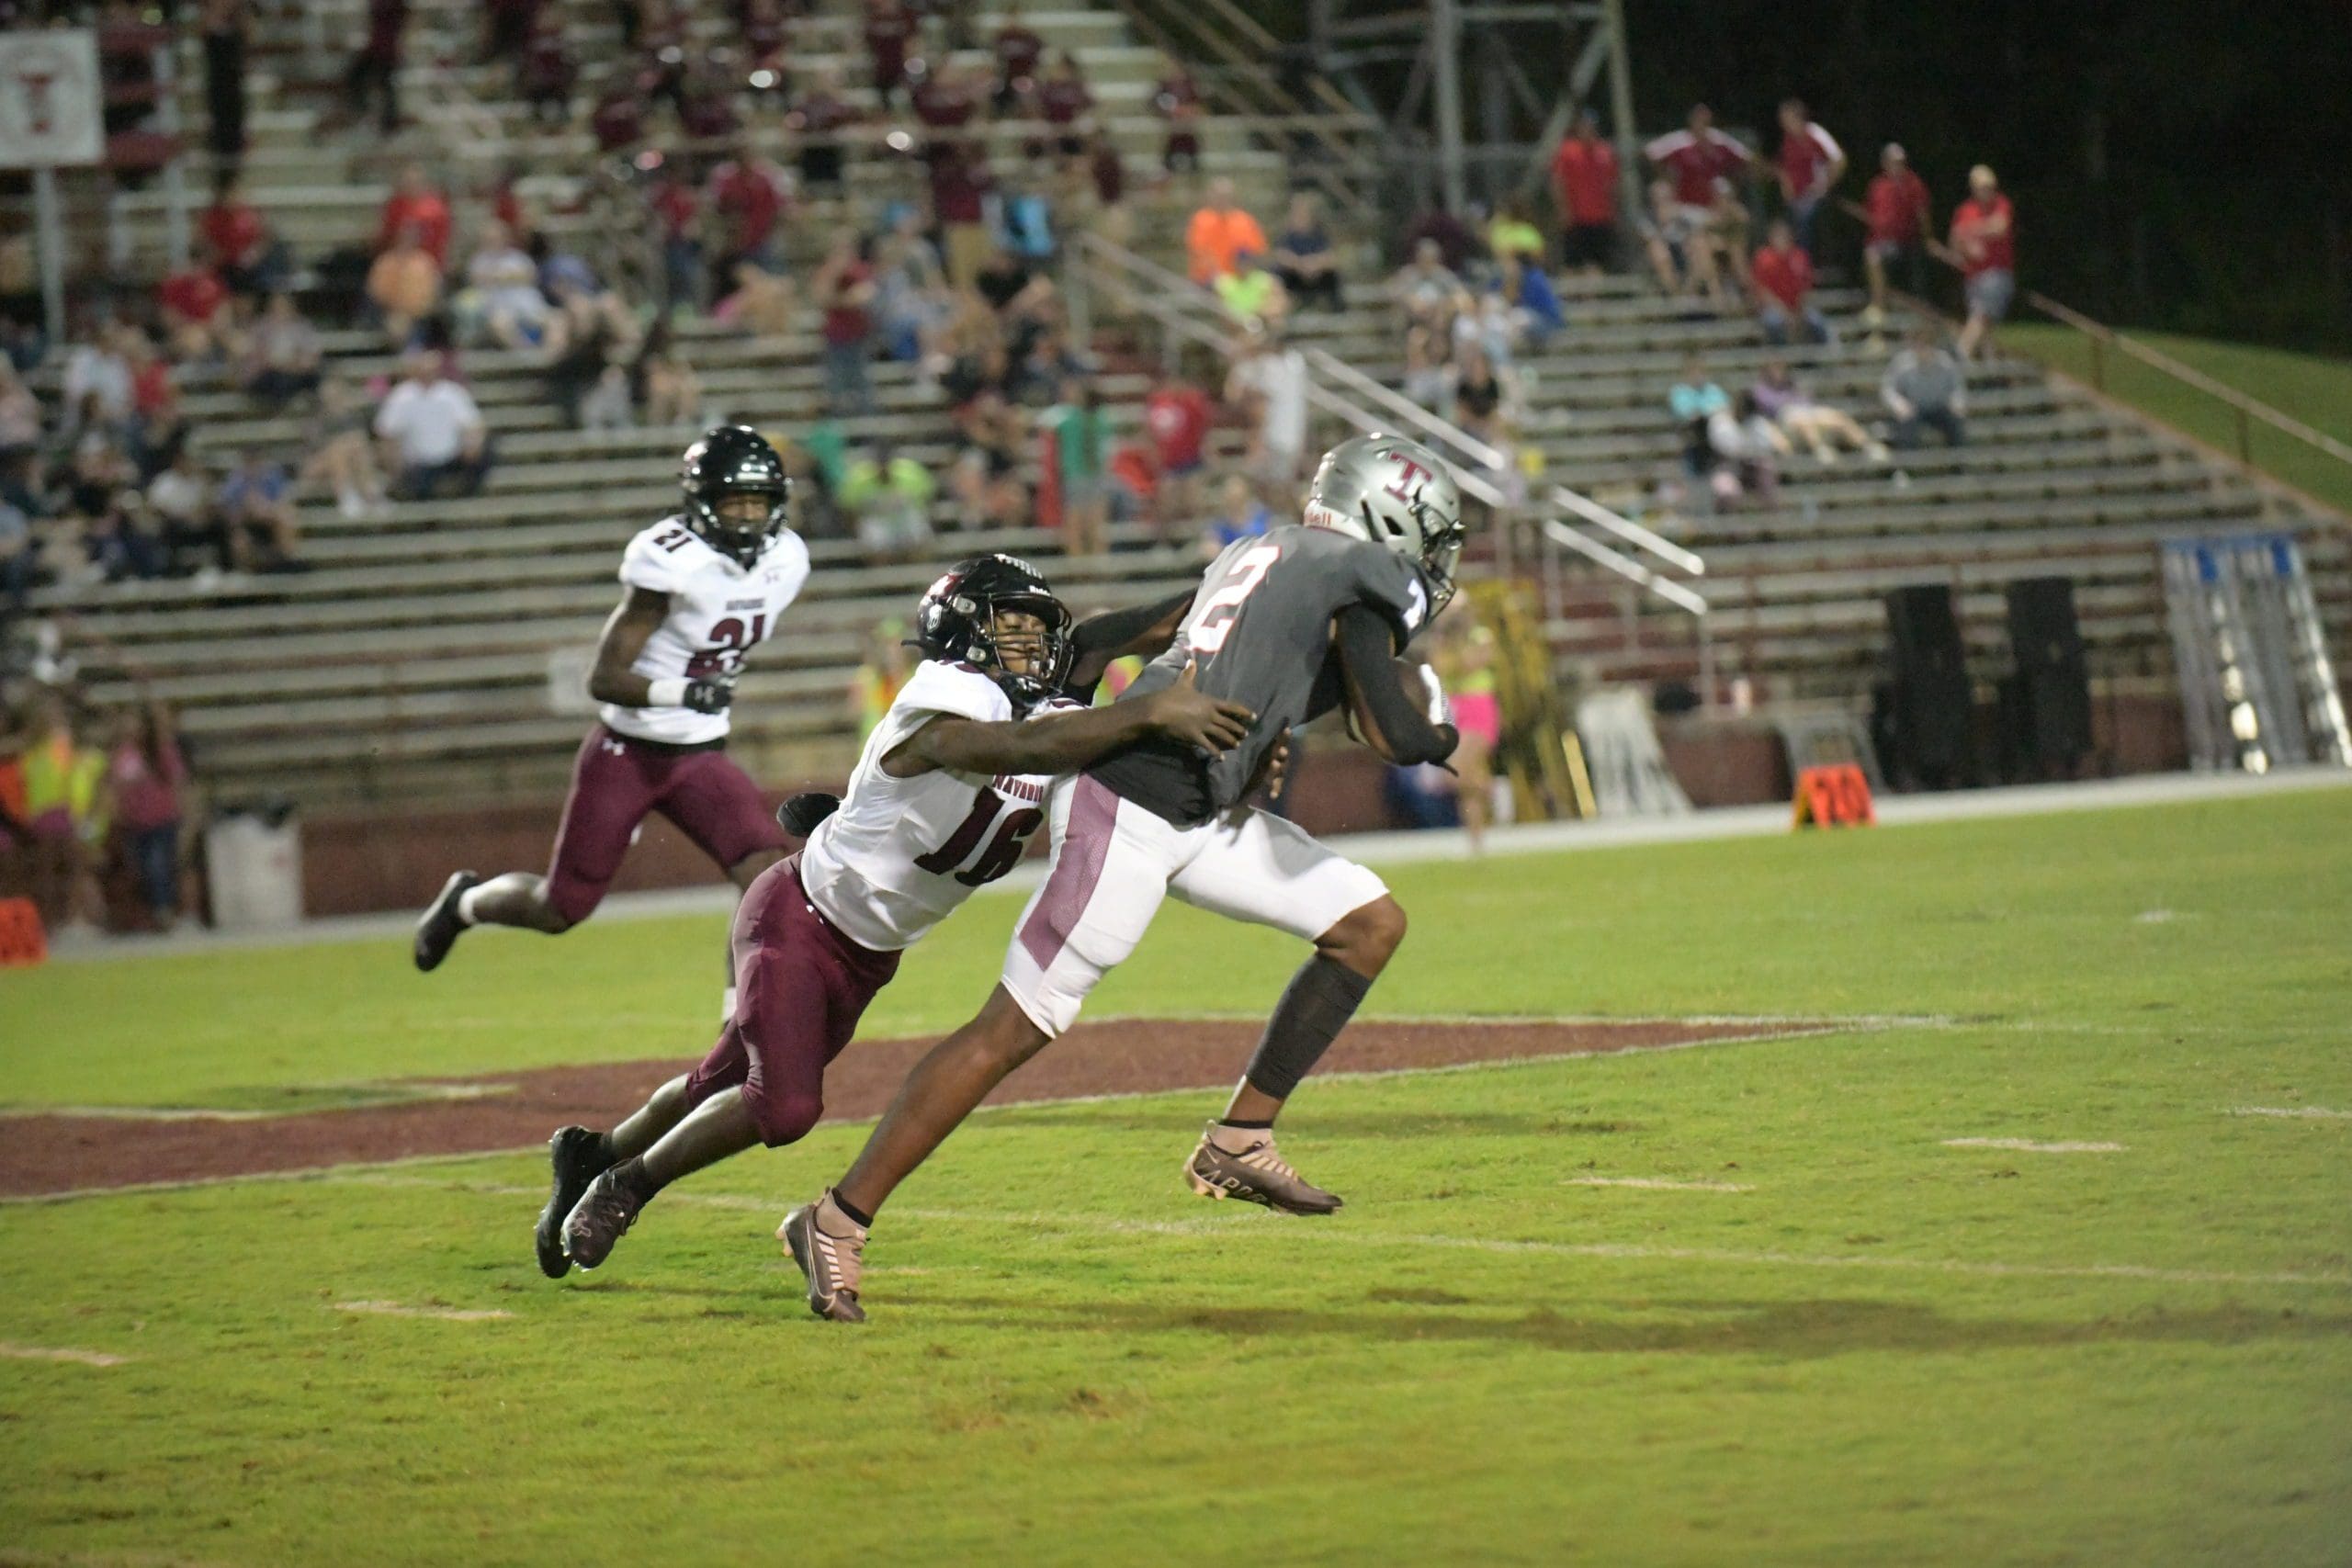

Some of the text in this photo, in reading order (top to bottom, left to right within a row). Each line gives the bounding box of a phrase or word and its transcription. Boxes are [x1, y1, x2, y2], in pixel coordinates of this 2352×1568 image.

[1384, 451, 1433, 502] T
[653, 529, 693, 553] 21
[1187, 544, 1283, 655] 2
[684, 614, 766, 678] 21
[912, 785, 1044, 886] 16
